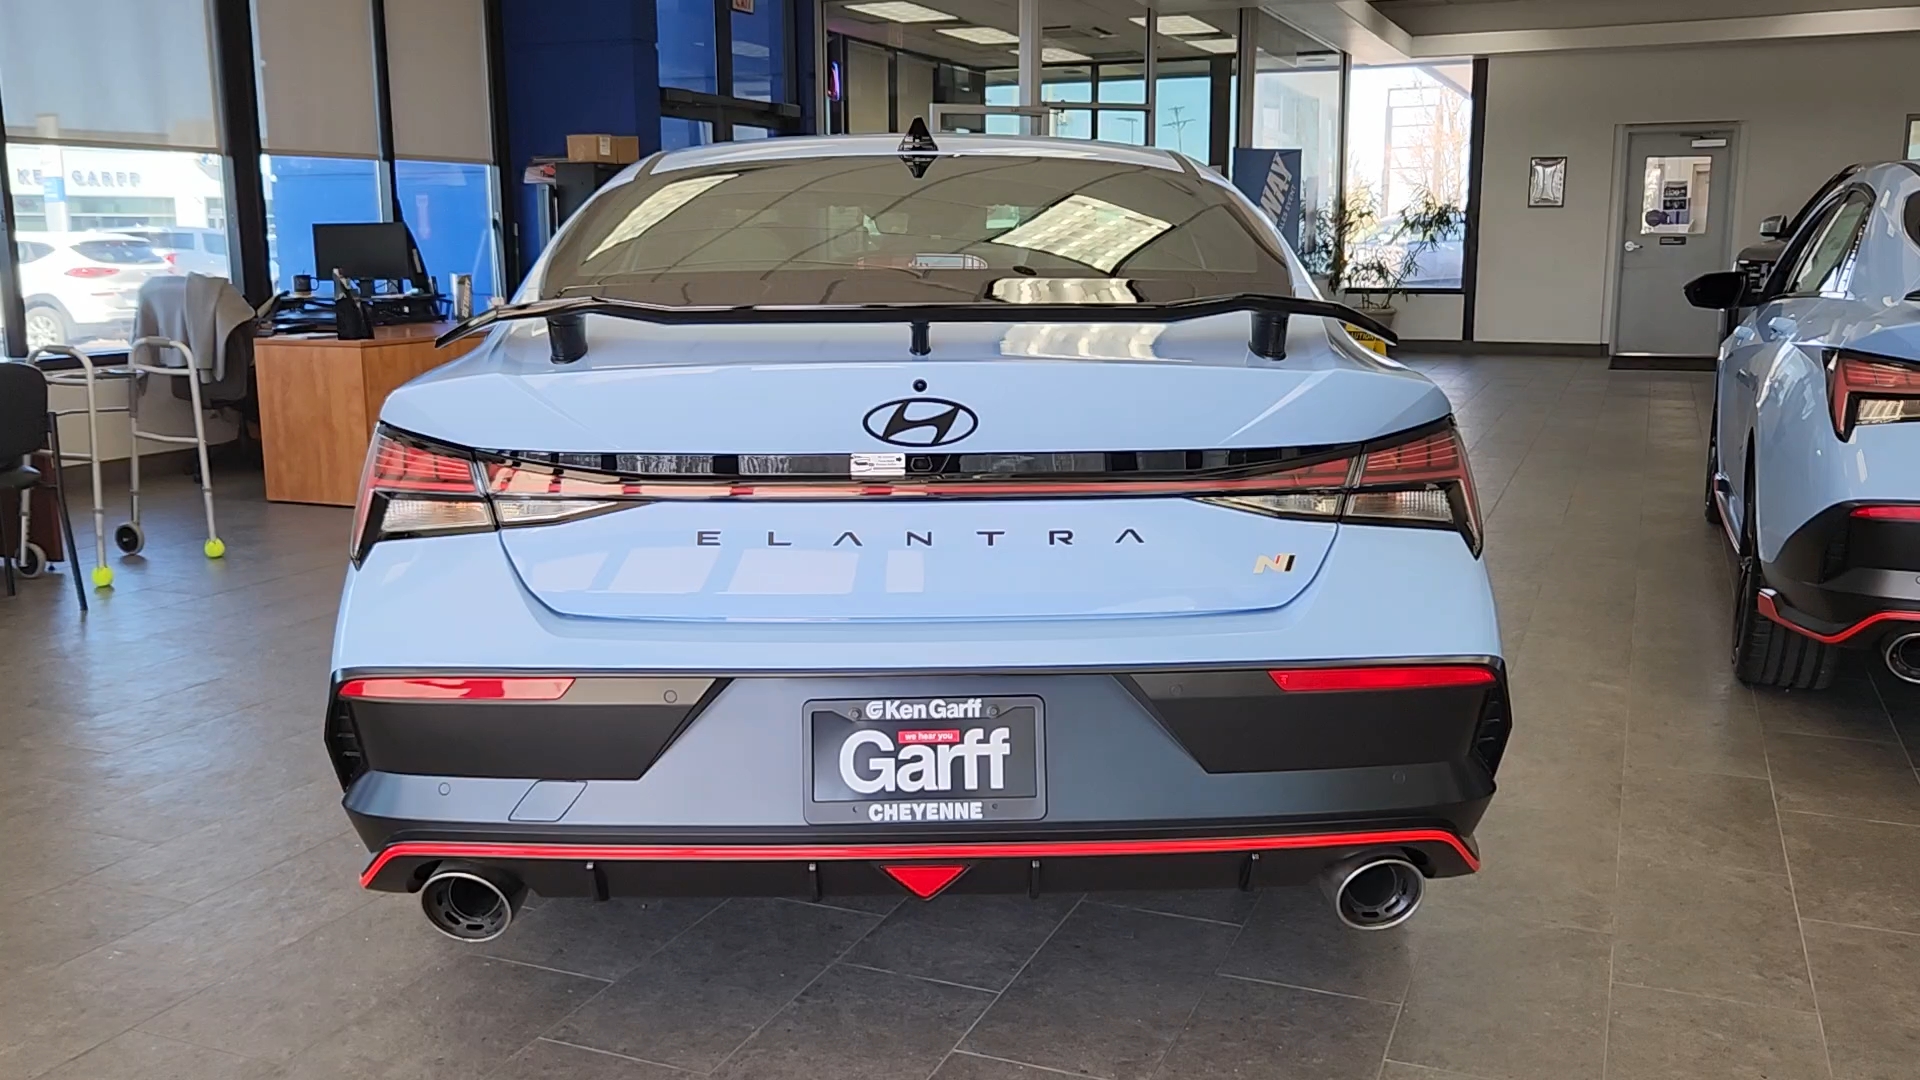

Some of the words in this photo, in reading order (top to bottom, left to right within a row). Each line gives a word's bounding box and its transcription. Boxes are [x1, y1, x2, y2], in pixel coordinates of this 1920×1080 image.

[1279, 212, 1289, 232] ALES
[1286, 184, 1297, 212] EVENT
[696, 528, 1146, 547] ELANTRA
[885, 700, 926, 720] Ken
[929, 698, 983, 719] Garff
[904, 733, 917, 741] we
[918, 732, 937, 741] hear
[938, 732, 953, 742] you
[839, 728, 1011, 794] Garff
[868, 802, 984, 822] CHEYENNE
